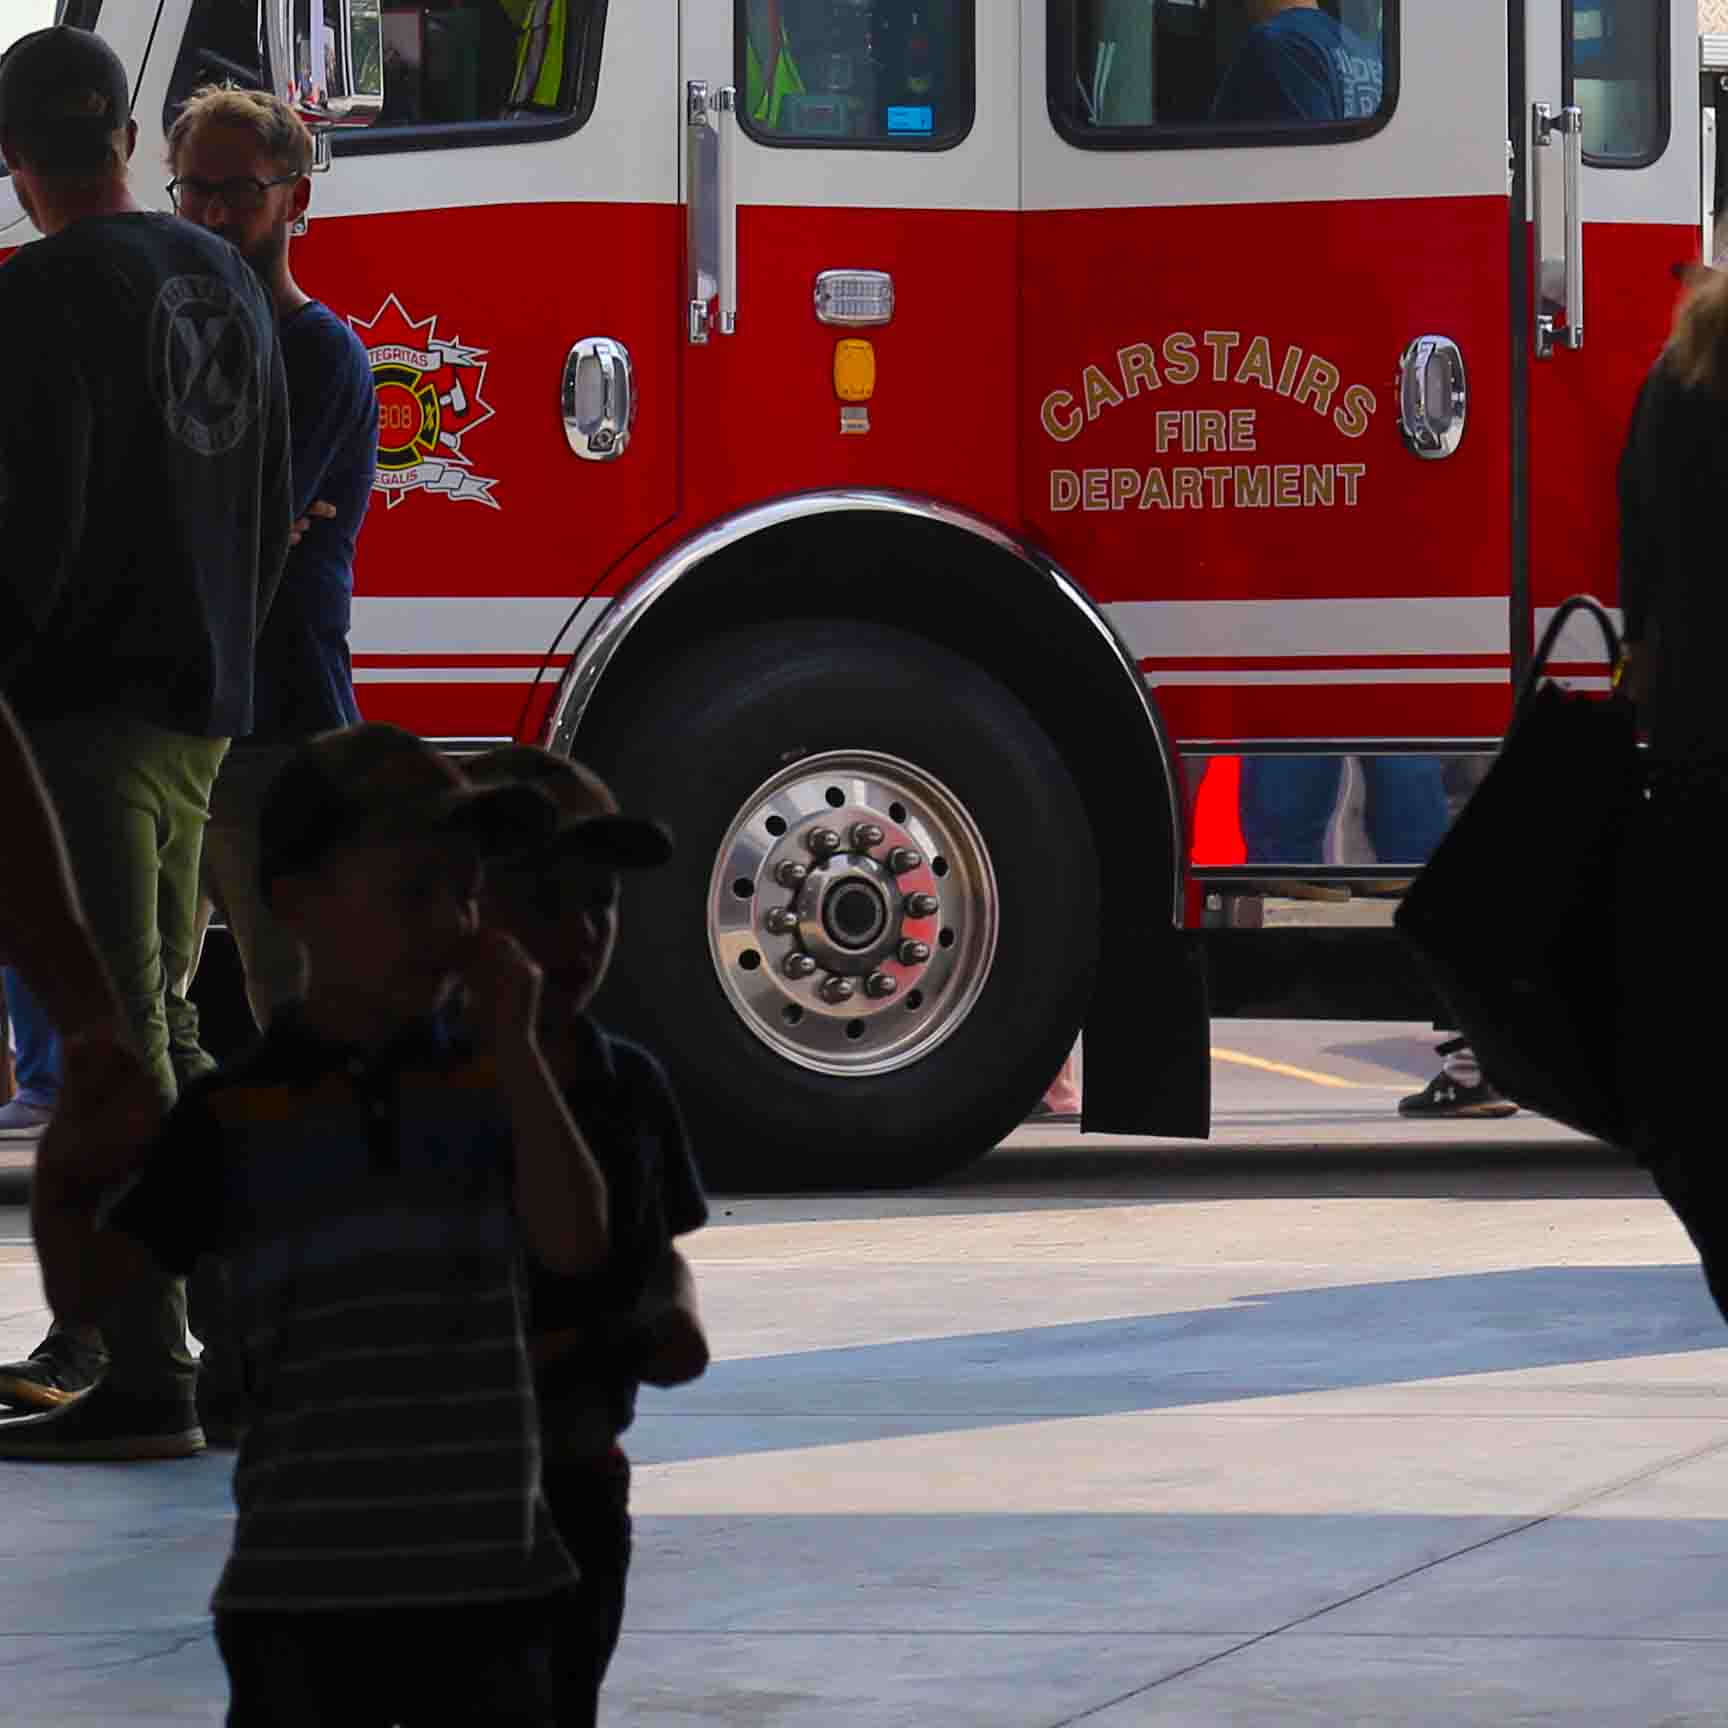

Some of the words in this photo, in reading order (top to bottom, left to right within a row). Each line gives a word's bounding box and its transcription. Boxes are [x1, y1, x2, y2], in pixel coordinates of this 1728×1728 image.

[1041, 330, 1377, 441] CARSTAIRS
[1155, 410, 1256, 453] FIRE
[1050, 465, 1366, 512] DEPARTMENT
